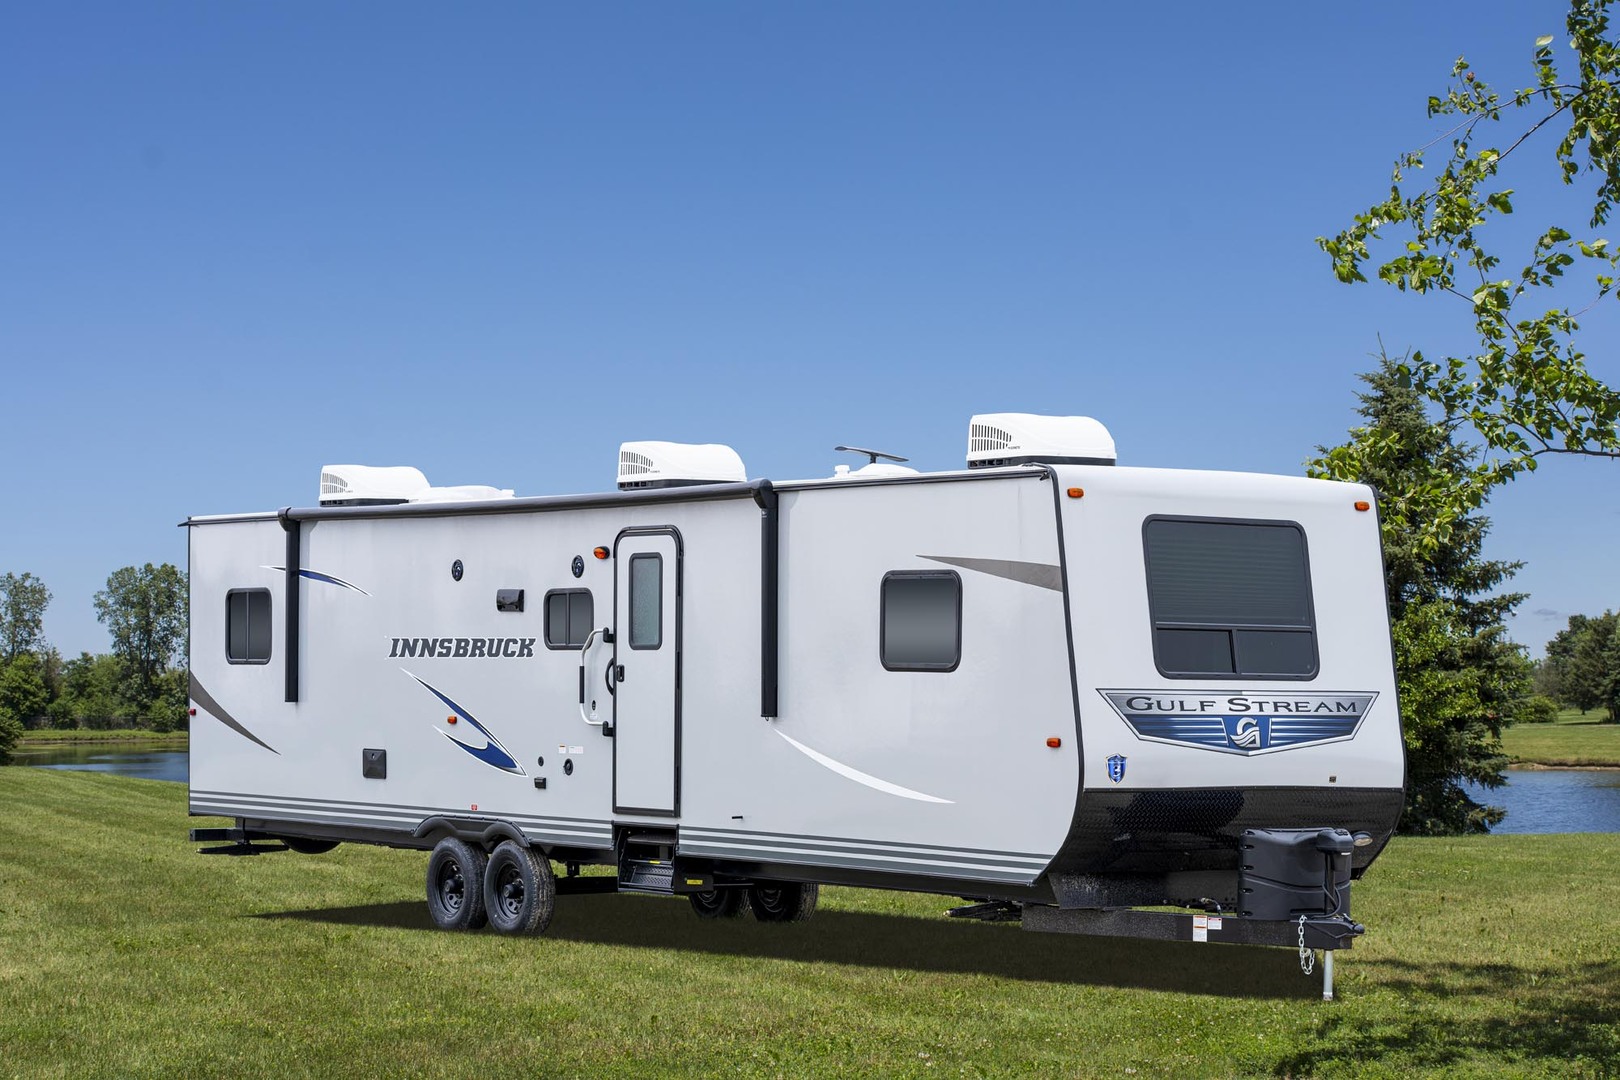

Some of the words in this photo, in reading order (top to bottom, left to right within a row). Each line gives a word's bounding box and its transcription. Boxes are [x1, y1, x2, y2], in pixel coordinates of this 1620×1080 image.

[388, 637, 537, 658] INNSBRUCK
[1126, 696, 1217, 712] GULF
[1227, 697, 1357, 713] STREAM
